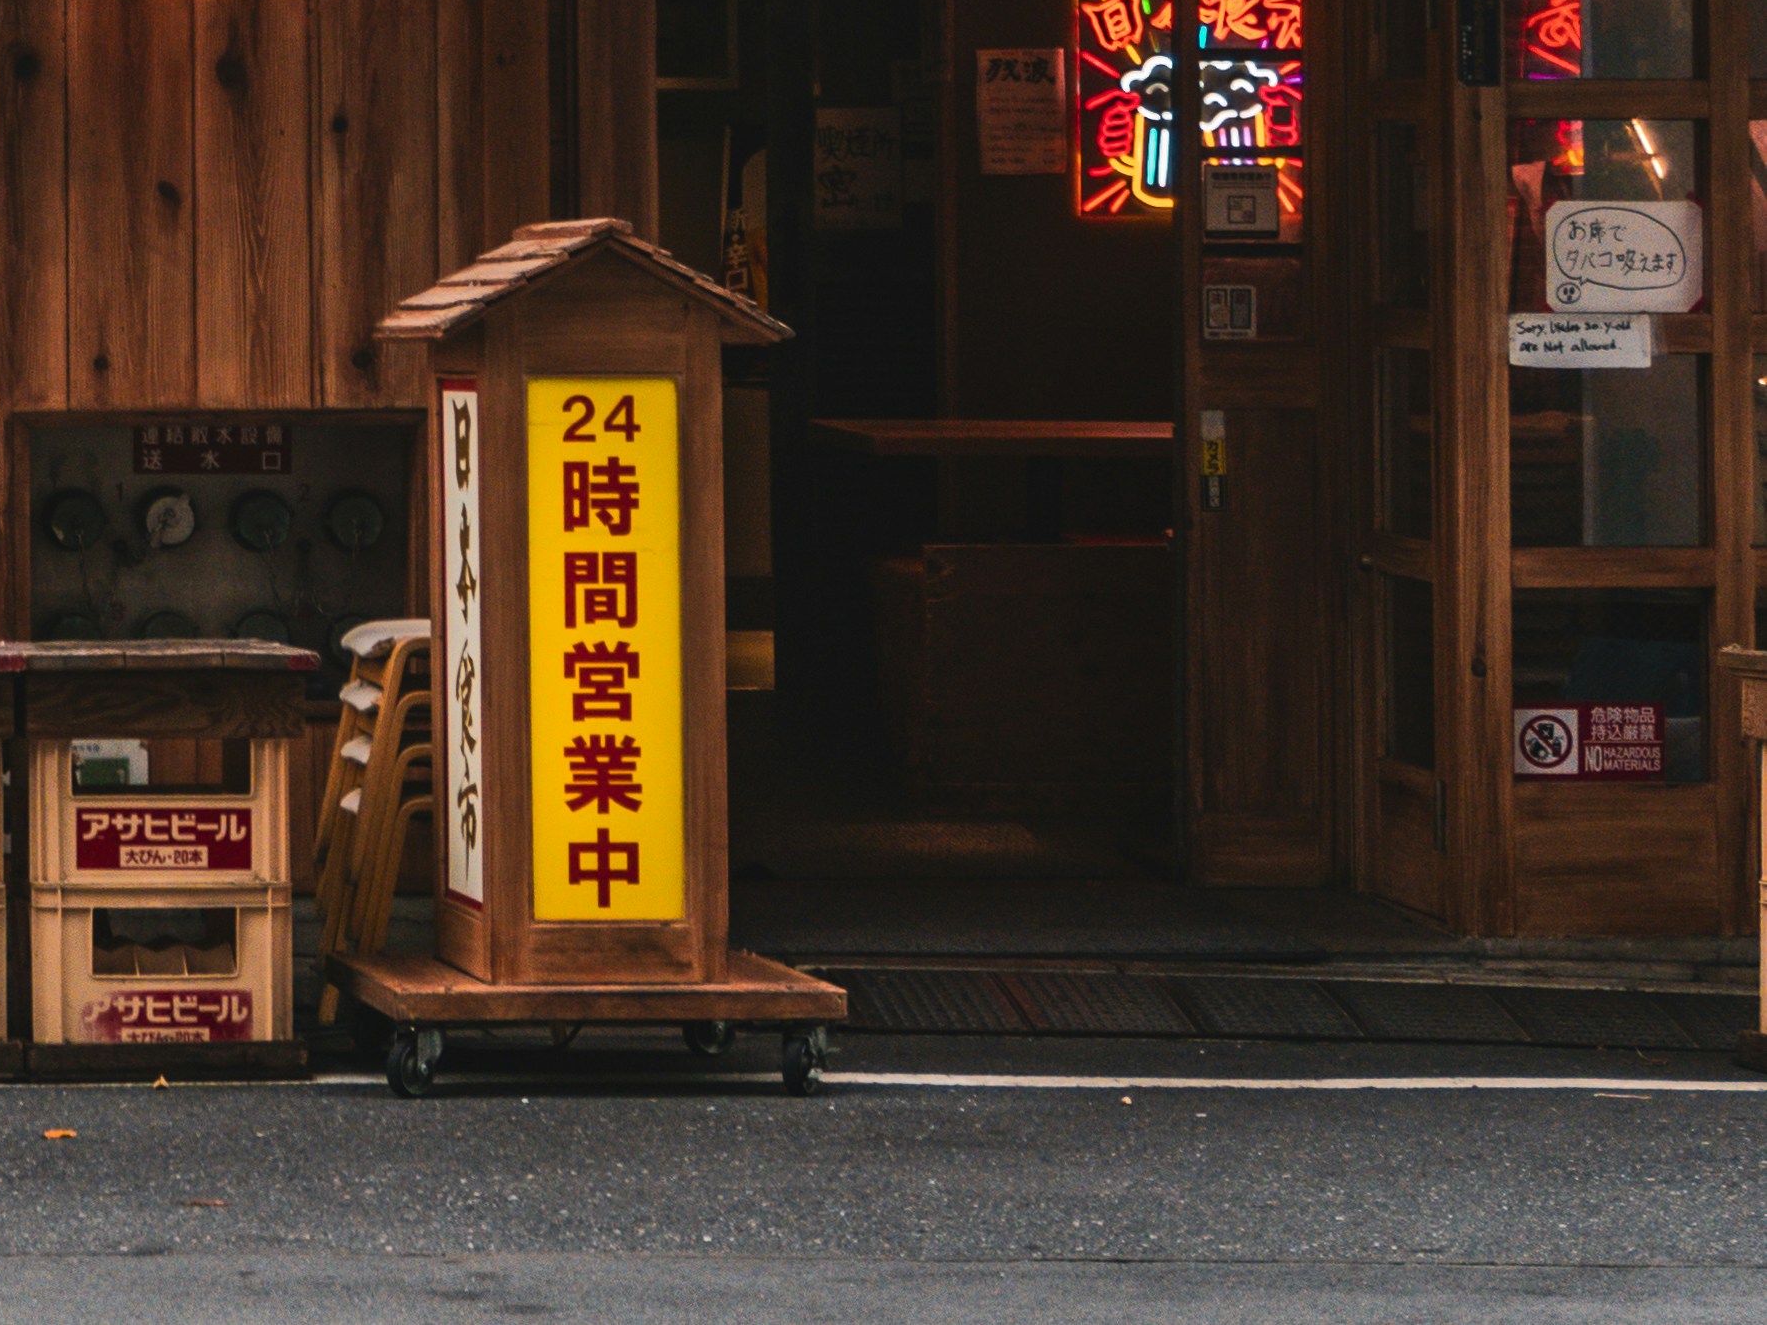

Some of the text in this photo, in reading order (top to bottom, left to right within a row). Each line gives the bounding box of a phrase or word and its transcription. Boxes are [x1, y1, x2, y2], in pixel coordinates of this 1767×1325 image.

[1568, 218, 1627, 244] お席で
[1566, 249, 1678, 276] タバコ吸えます
[141, 449, 282, 471] 送水口
[452, 398, 479, 888] 日本食市
[561, 394, 644, 910] 24時間営業中
[1590, 706, 1656, 725] 危険物品
[1590, 724, 1656, 742] 持込厳禁
[1584, 745, 1603, 773] NO
[1603, 746, 1661, 758] HAZARDOUS
[1603, 759, 1661, 771] MATERIALS
[81, 813, 248, 842] アサヒビール
[83, 995, 250, 1024] アサヒビール
